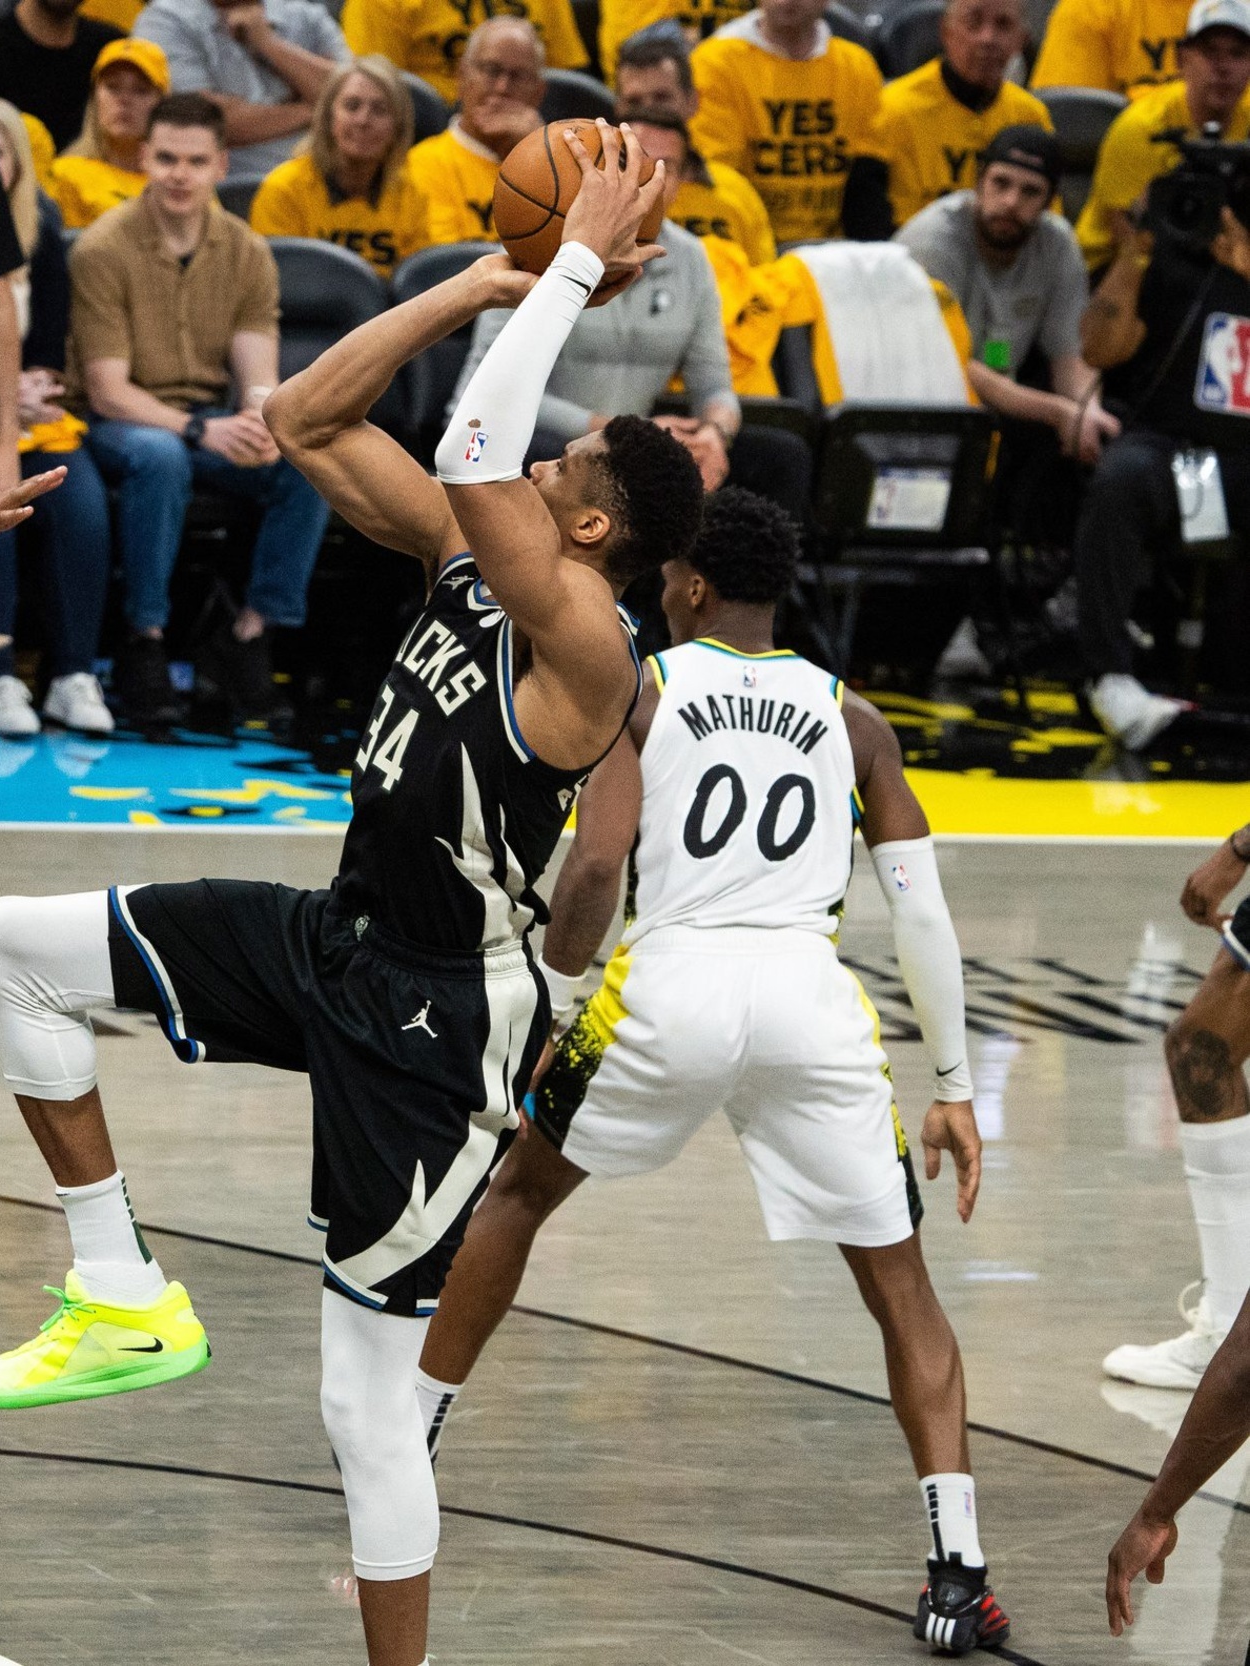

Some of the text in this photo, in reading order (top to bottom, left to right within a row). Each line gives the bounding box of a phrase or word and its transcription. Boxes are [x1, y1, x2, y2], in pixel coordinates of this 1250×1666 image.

[762, 98, 837, 136] YES
[677, 694, 829, 756] MATHURIN
[682, 762, 817, 863] 00
